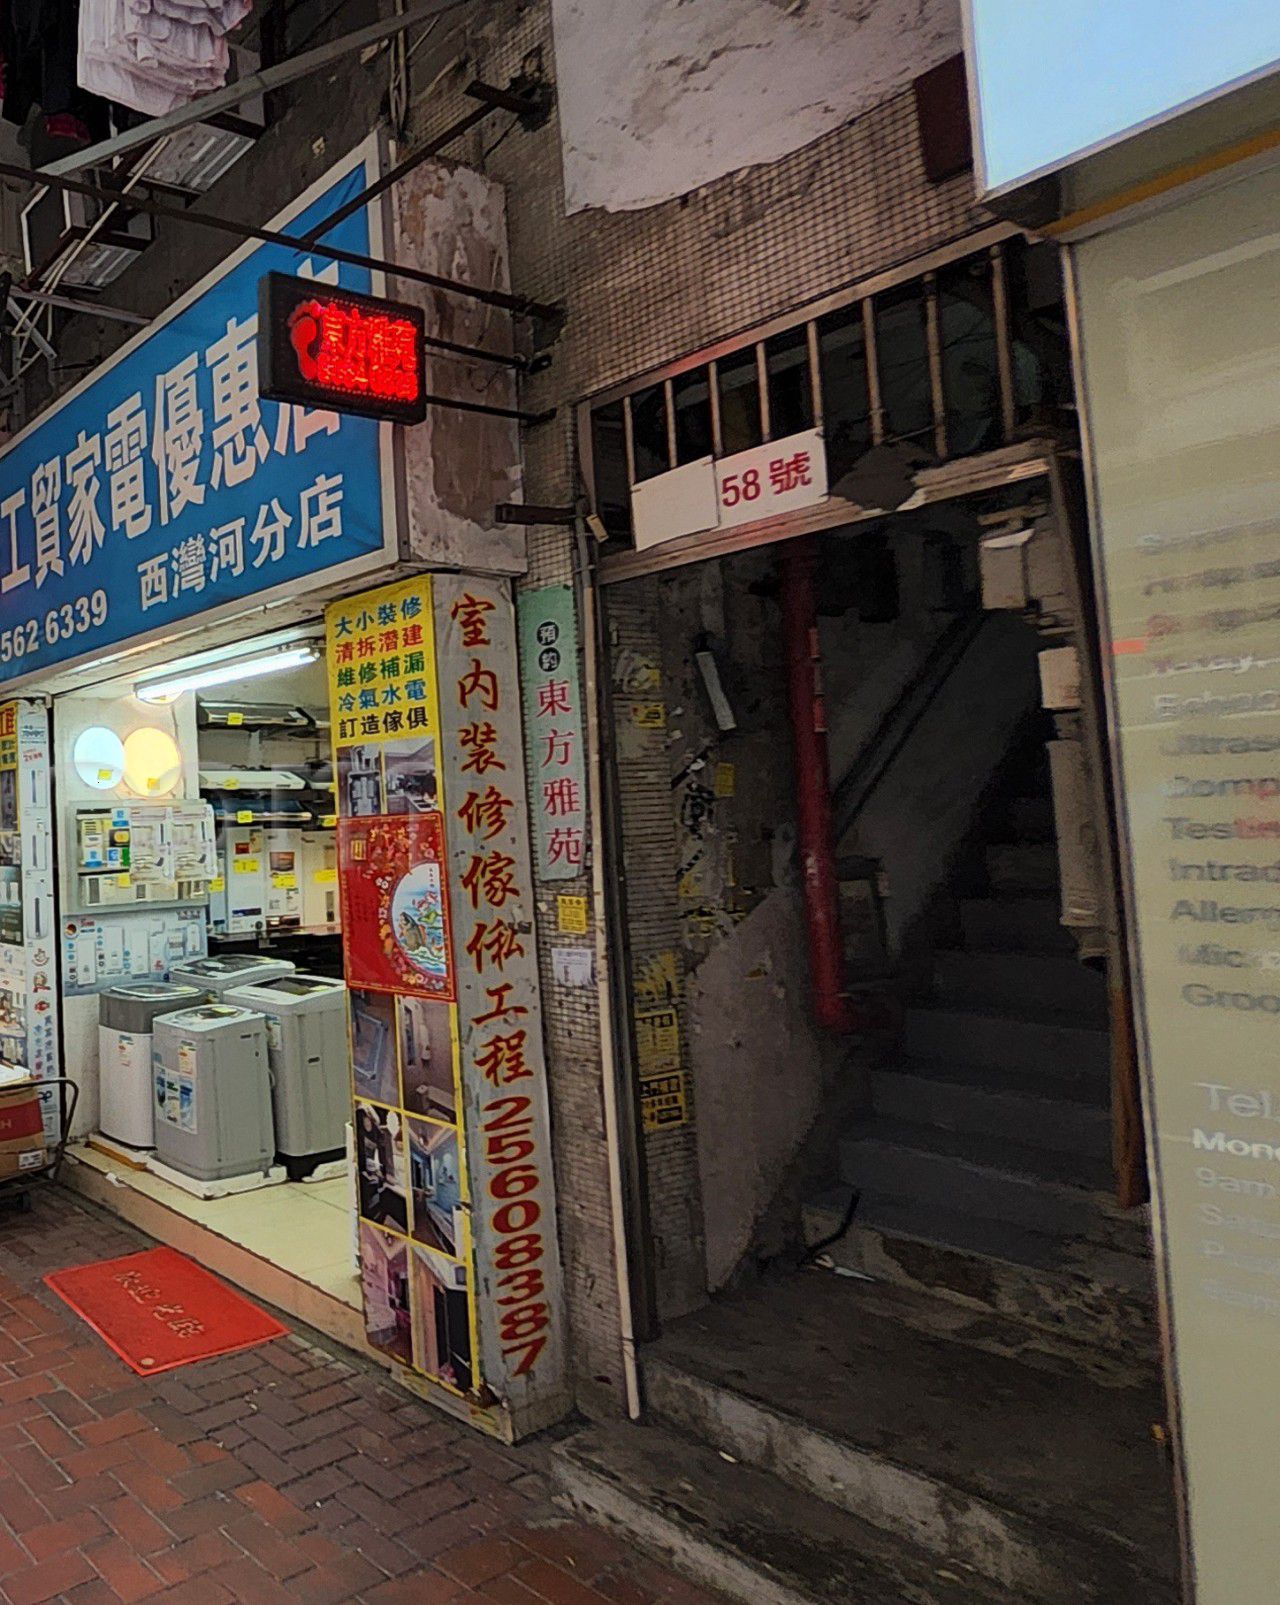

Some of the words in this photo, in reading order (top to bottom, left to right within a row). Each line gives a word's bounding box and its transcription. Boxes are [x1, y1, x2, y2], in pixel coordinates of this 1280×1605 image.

[722, 469, 761, 507] 58
[769, 451, 812, 495] 號
[137, 473, 343, 612] 西灣河分店
[45, 589, 108, 644] 6339
[335, 596, 422, 638] 大小裝修
[337, 651, 425, 688] 維修補漏
[338, 678, 428, 712] 冷氣水電
[339, 706, 429, 739] 訂造傢俱
[536, 678, 584, 866] 東方雅苑
[483, 1097, 550, 1377] 25608387
